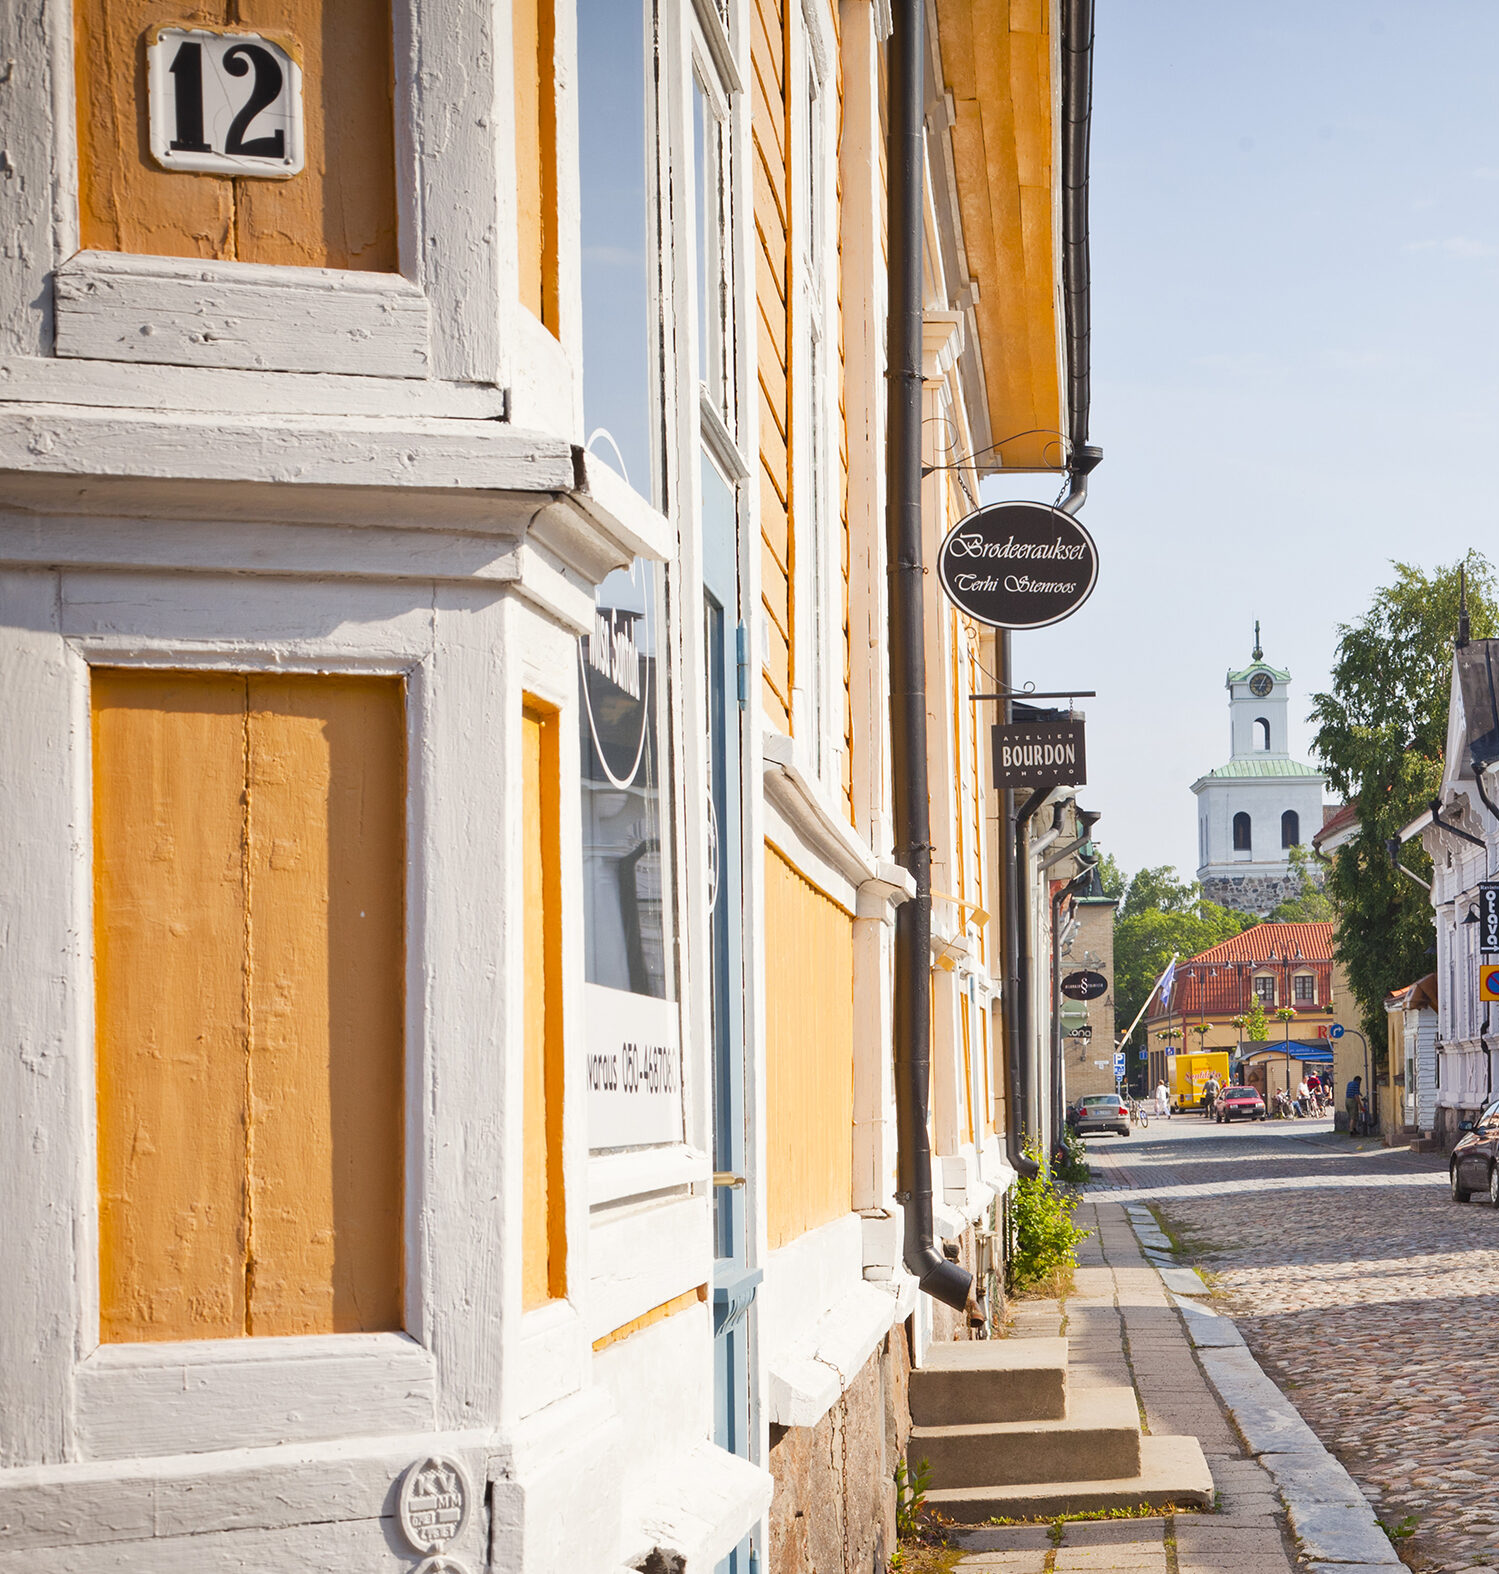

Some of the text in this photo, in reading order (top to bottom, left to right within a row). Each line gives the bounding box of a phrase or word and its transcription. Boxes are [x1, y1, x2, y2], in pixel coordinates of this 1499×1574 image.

[168, 41, 285, 158] 12
[950, 532, 1087, 560] Brodeeraukset
[954, 573, 1077, 593] Terhi Stenroos
[1003, 733, 1074, 742] ATELIER
[1002, 743, 1076, 768] BOURDON
[1005, 769, 1075, 777] PHOTO
